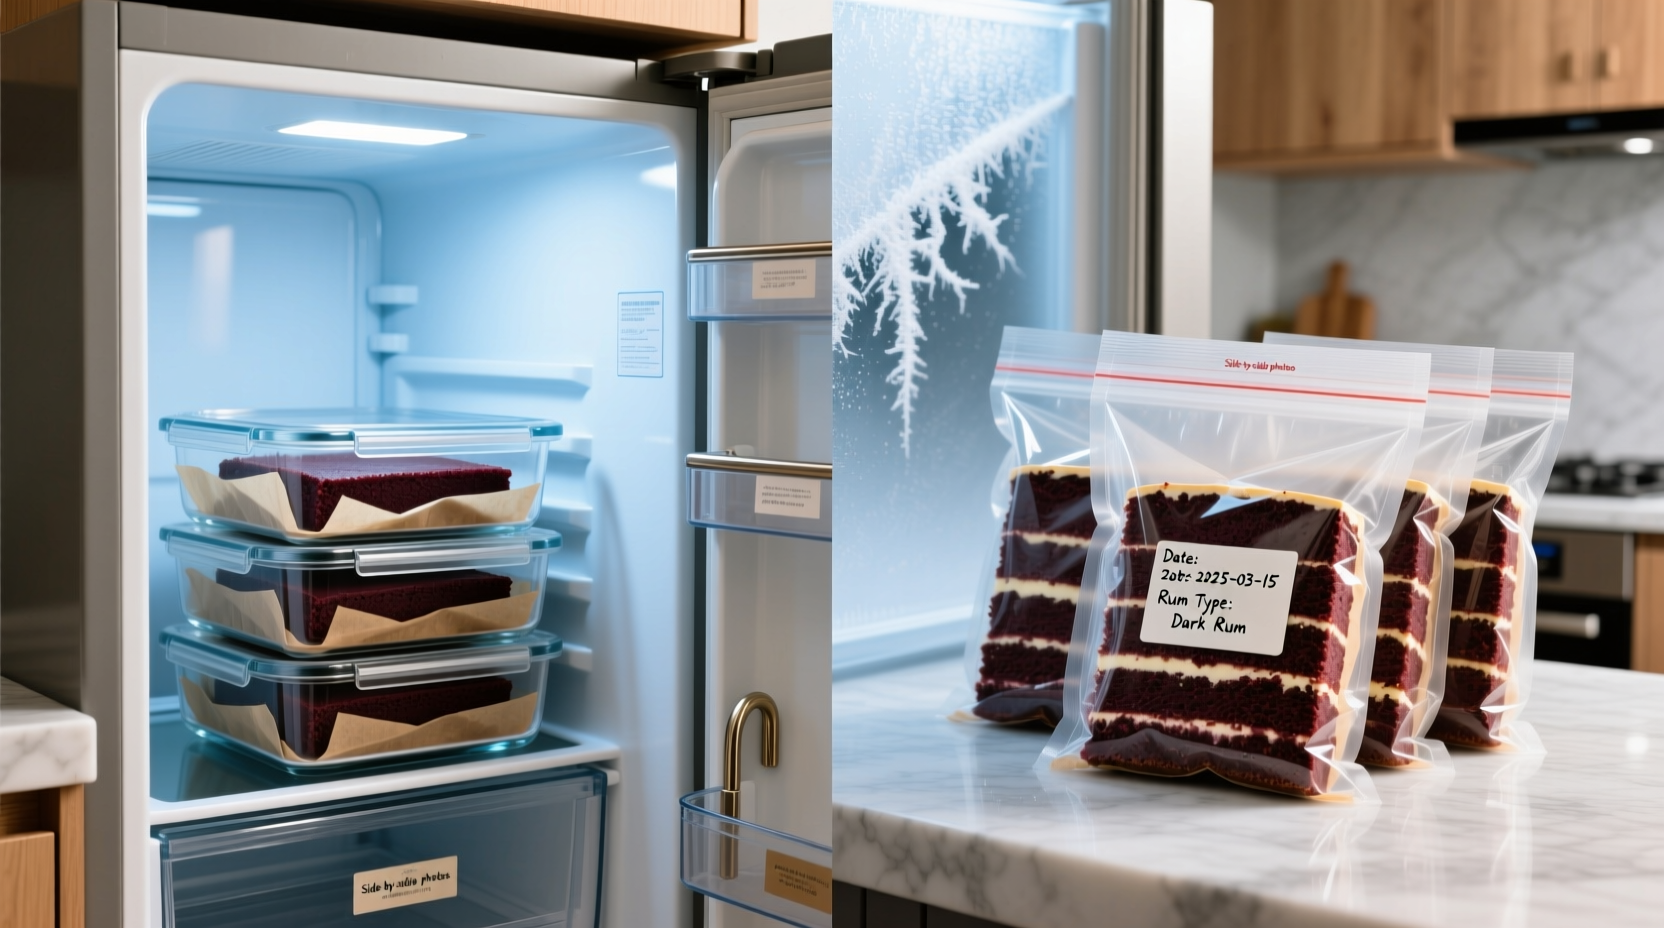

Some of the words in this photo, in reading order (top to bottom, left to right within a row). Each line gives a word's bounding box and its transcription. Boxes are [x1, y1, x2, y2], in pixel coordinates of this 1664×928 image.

[1163, 548, 1198, 565] Date:
[1195, 571, 1280, 588] 2025-03-15
[1157, 589, 1188, 606] Rum
[1195, 593, 1233, 615] Type:
[1171, 613, 1206, 631] Dark
[1213, 616, 1246, 634] Rum
[361, 882, 381, 894] Side
